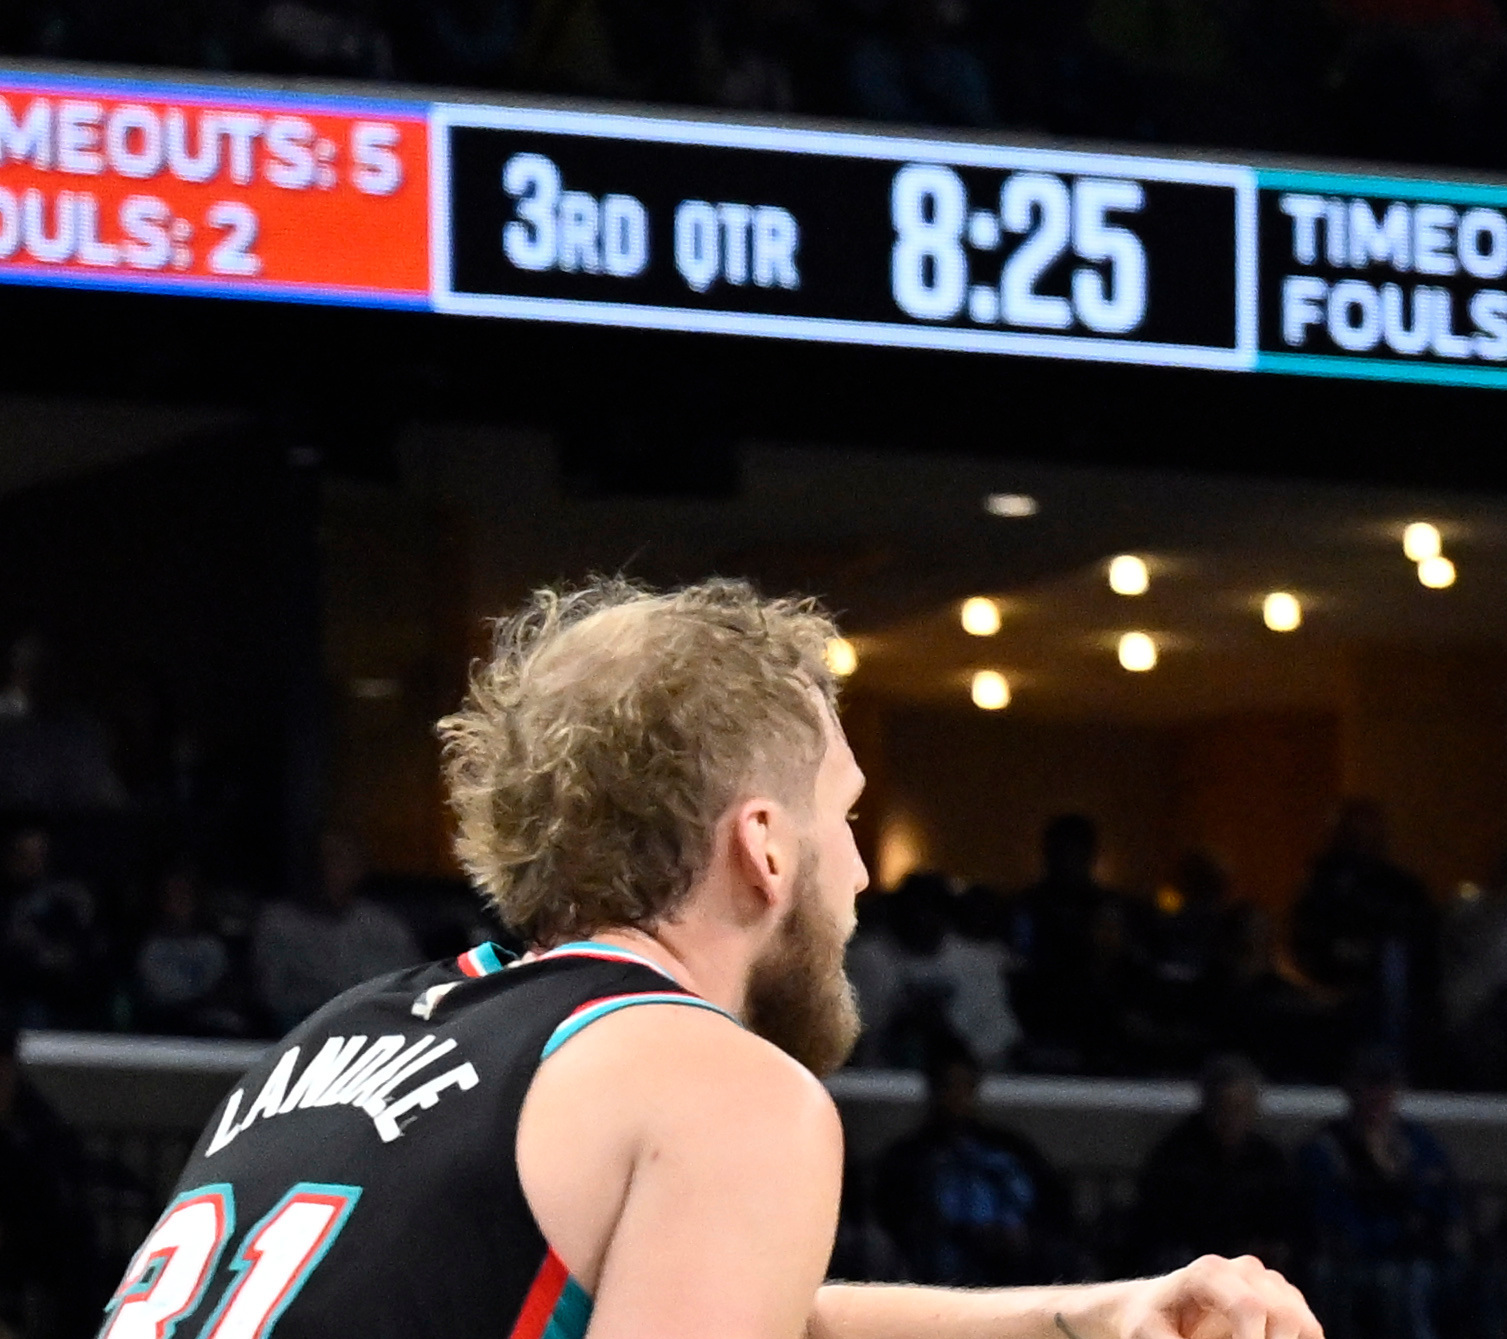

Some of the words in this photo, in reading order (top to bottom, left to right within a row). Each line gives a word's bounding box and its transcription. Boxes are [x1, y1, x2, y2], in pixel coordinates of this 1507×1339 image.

[350, 122, 404, 197] 5
[205, 200, 263, 276] 2
[501, 152, 650, 278] 3RD
[673, 199, 801, 294] QTR
[889, 162, 1150, 334] 8:25
